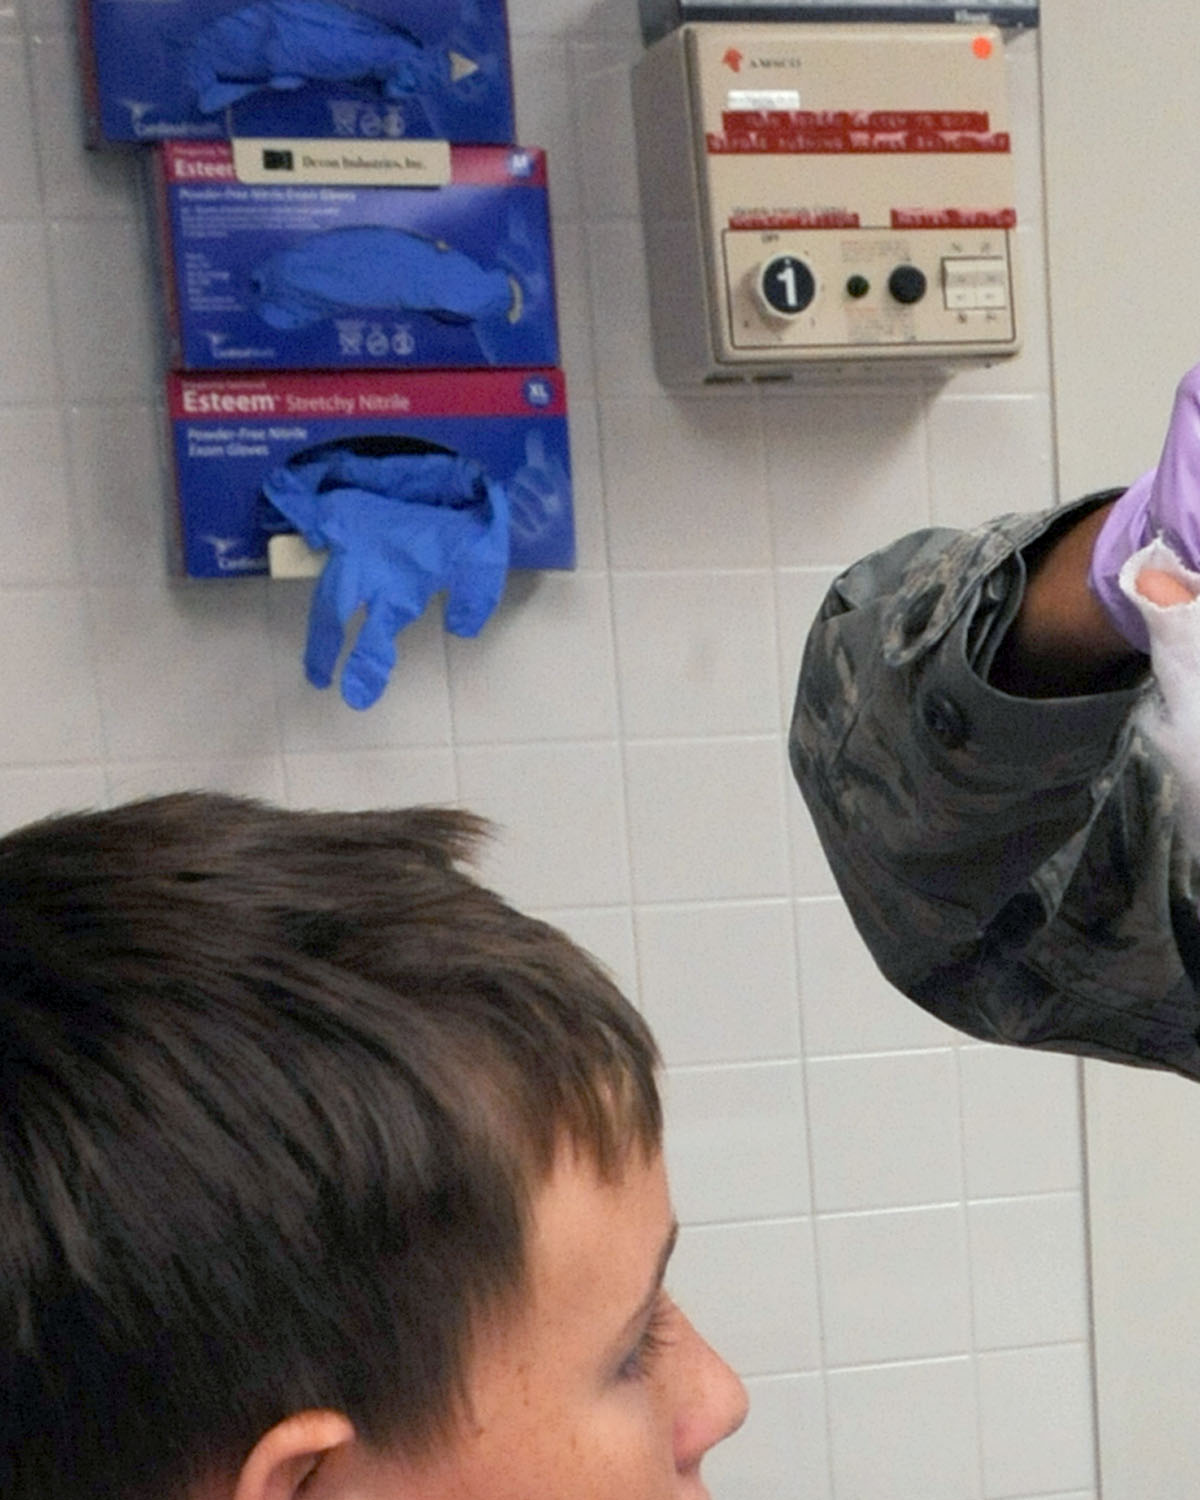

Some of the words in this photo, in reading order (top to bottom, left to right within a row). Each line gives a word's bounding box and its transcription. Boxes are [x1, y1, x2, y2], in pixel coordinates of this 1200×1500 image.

[528, 383, 549, 404] XL
[286, 395, 355, 414] Stretchy
[359, 395, 410, 412] Nitrile
